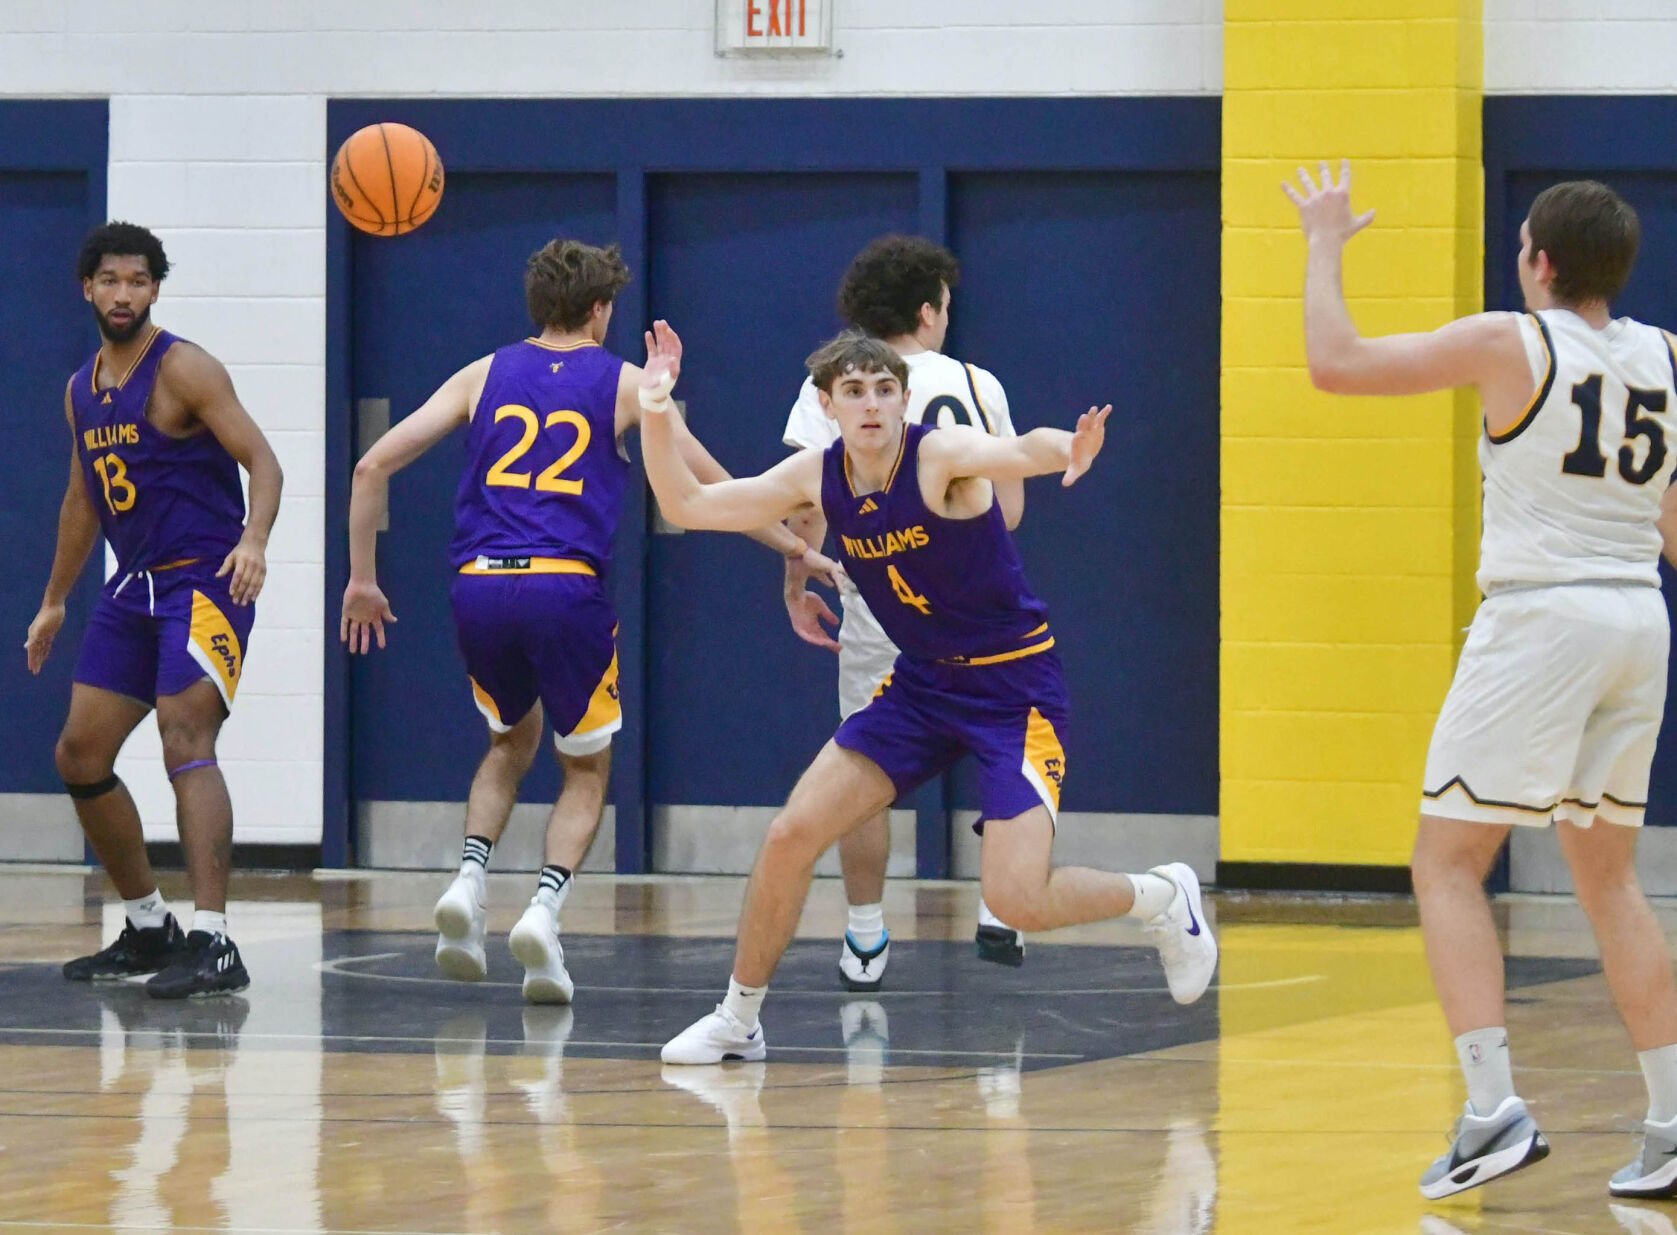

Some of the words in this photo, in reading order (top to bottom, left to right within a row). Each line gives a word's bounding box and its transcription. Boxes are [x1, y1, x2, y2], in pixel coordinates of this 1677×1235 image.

[747, 0, 806, 37] EXIT
[84, 423, 140, 451] WILLIAMS
[485, 403, 592, 496] 22
[1561, 373, 1668, 485] 15
[93, 452, 137, 516] 13
[841, 525, 931, 560] WILLIAMS
[886, 564, 934, 616] 4
